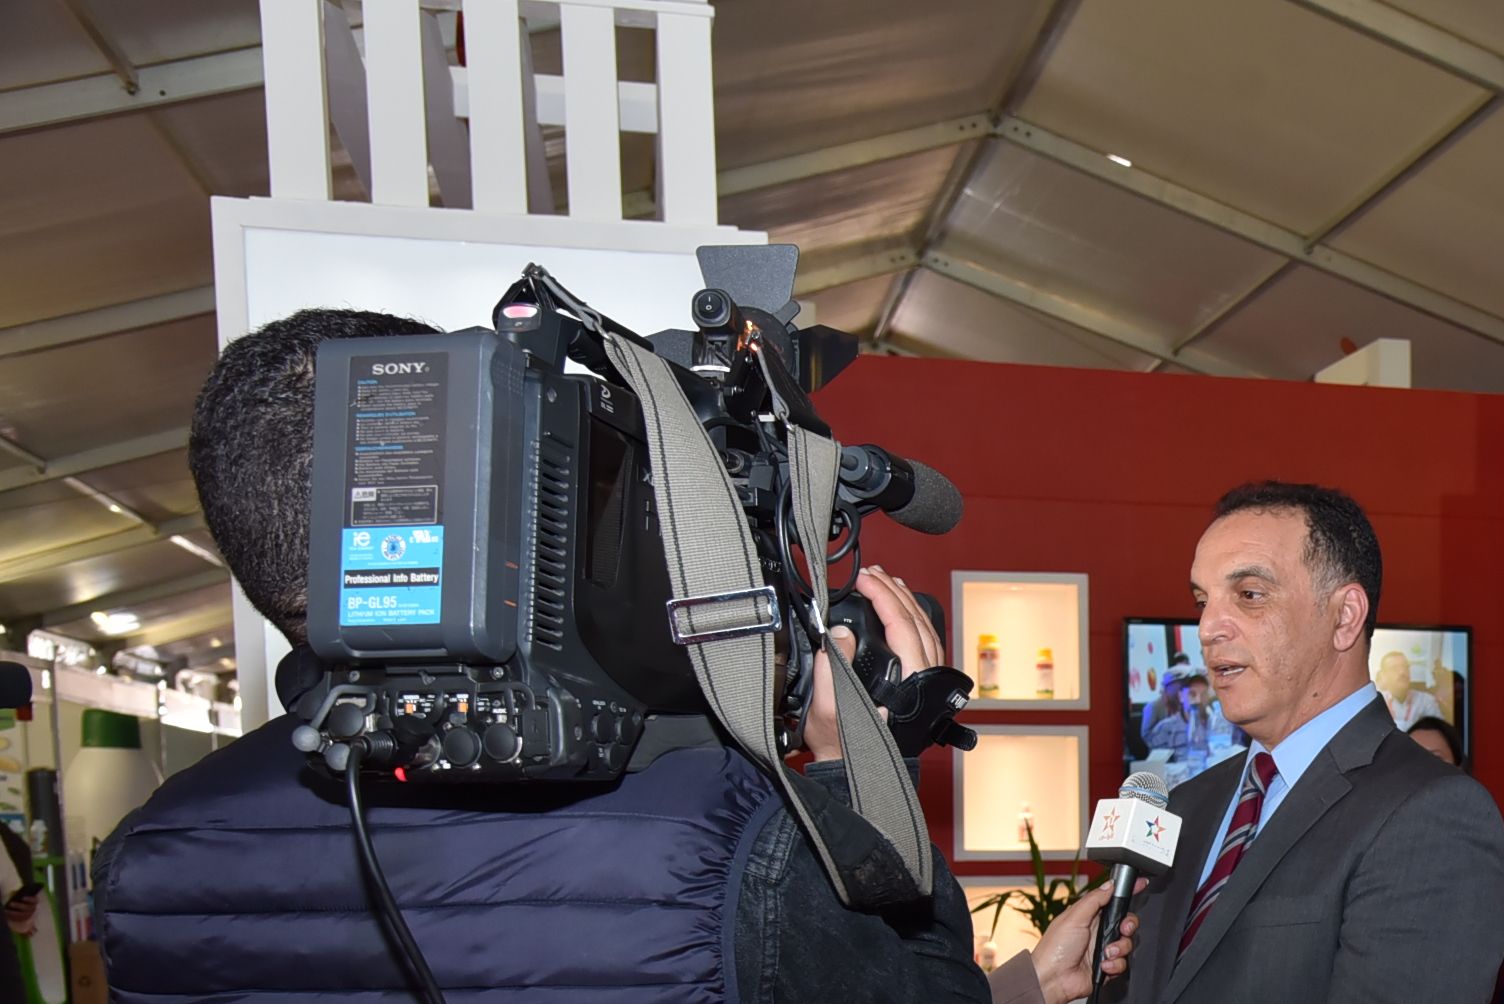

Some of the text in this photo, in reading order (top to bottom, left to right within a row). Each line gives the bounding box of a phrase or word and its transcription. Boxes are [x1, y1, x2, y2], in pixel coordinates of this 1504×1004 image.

[372, 362, 426, 376] SONY
[344, 572, 439, 584] Professional Info Battery
[347, 595, 397, 609] BP-GL95
